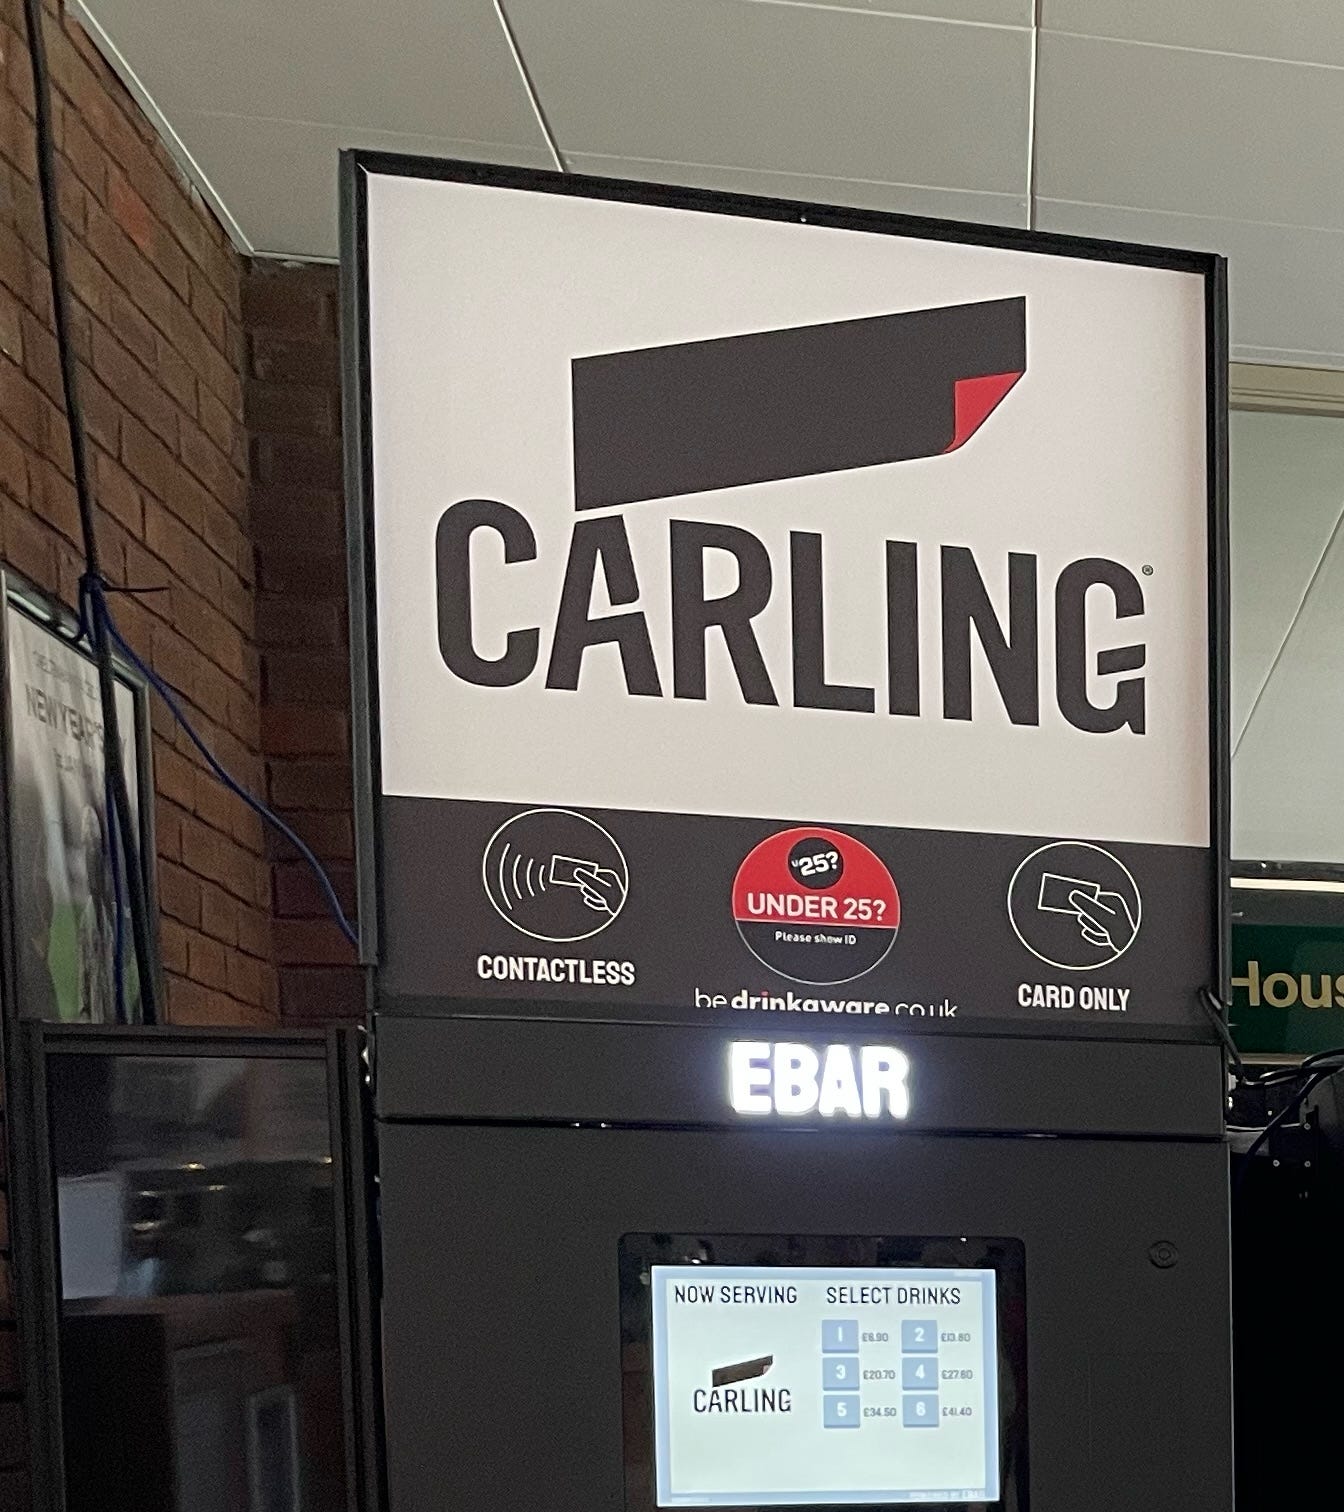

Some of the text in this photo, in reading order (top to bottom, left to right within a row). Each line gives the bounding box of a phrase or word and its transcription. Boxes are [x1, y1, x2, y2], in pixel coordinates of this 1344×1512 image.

[436, 499, 1146, 735] CARLING
[747, 892, 887, 922] UNDER 25?
[775, 930, 857, 945] Please show ID
[477, 954, 636, 986] CONTACTLESS
[1018, 983, 1130, 1011] CARD ONLY
[728, 1041, 910, 1118] EBAR
[675, 1286, 798, 1305] NOW SERVING
[826, 1287, 961, 1305] SELECT DRINKS
[914, 1327, 925, 1342] 2
[835, 1364, 846, 1379] 3
[863, 1370, 896, 1380] £20.70
[915, 1364, 925, 1379] 4
[693, 1389, 792, 1413] CARLING
[836, 1402, 847, 1417] 5
[863, 1407, 897, 1417] £34.50
